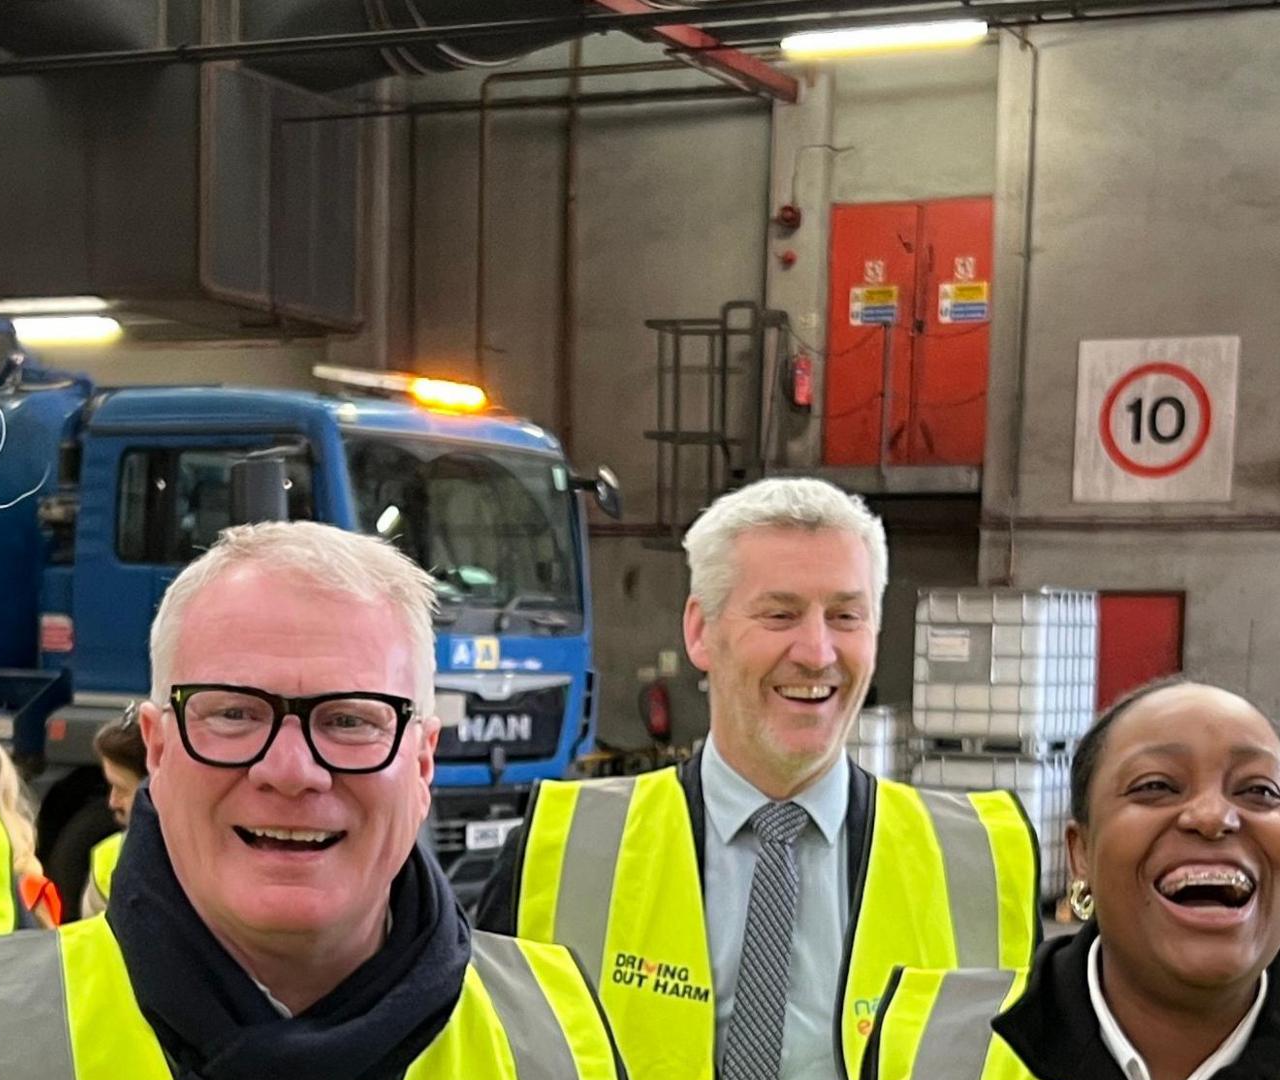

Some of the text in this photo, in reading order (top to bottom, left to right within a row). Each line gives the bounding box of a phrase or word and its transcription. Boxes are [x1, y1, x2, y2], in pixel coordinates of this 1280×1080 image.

[1125, 396, 1186, 445] 10
[457, 713, 533, 742] MAN
[615, 953, 689, 982] DRIVING
[612, 968, 710, 1003] OUT HARM
